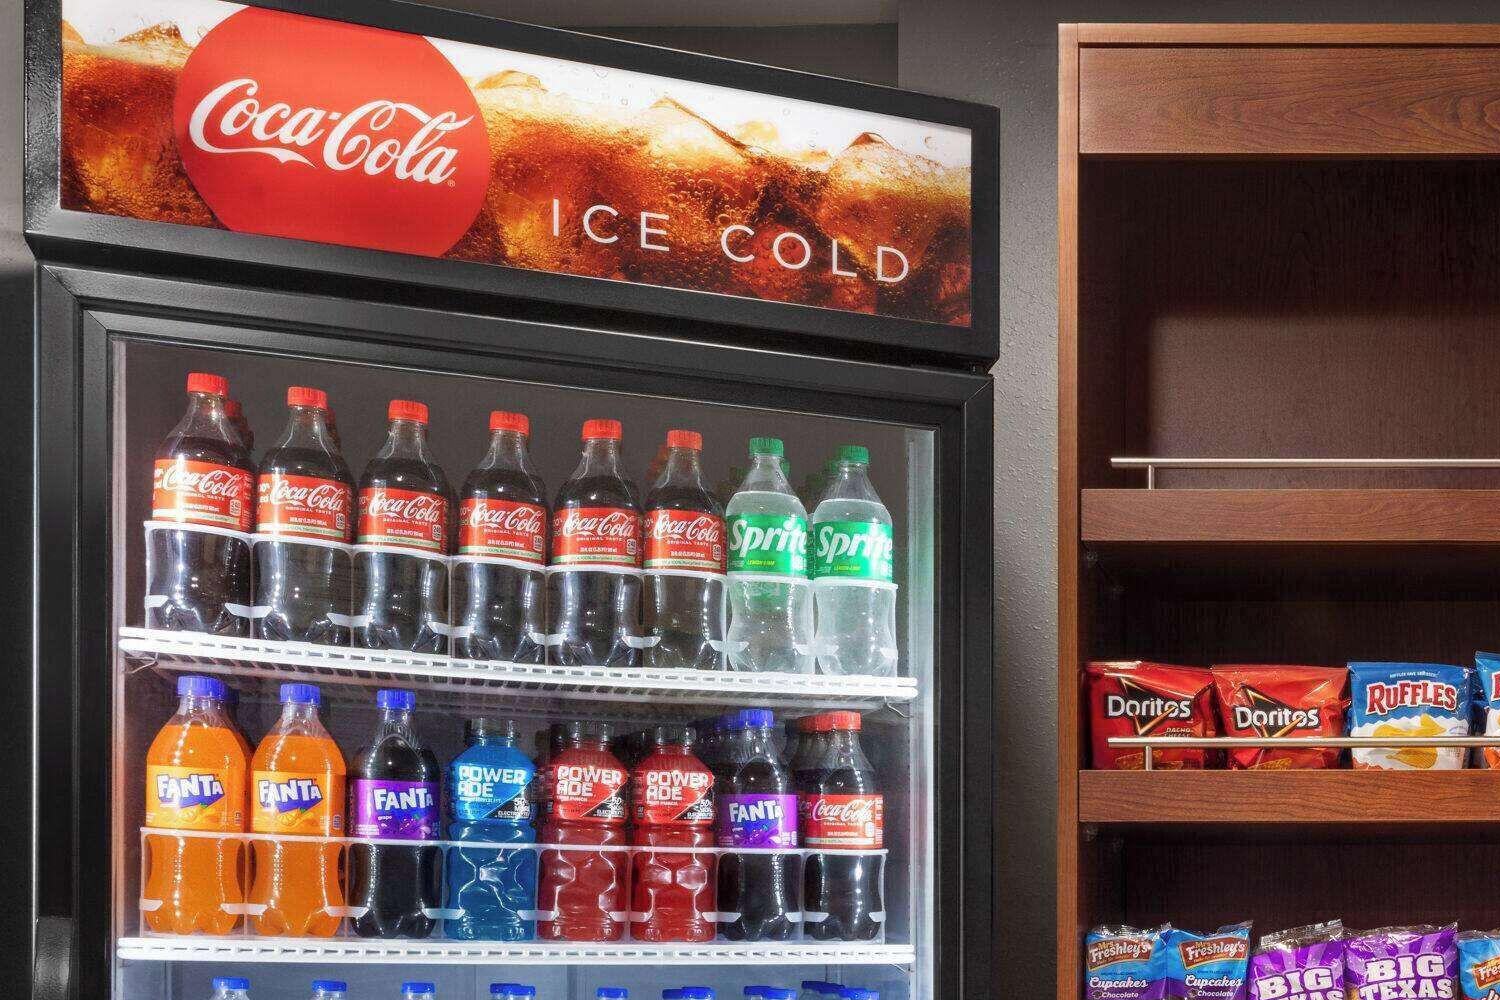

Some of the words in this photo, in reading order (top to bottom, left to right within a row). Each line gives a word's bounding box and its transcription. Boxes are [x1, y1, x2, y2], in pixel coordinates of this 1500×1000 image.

[189, 78, 475, 185] Coca-Cola
[552, 199, 670, 252] ICE
[721, 225, 911, 284] COLD
[162, 464, 242, 498] Coca-Cola
[271, 478, 345, 511] Coca-Cola
[368, 493, 441, 523] Coca-Cola
[470, 503, 543, 533] Coca-Cola
[563, 511, 635, 537] Coca-Cola
[653, 512, 719, 543] Coca-Cola
[1107, 695, 1191, 718] Doritos
[1367, 681, 1457, 714] RUFFLES
[1235, 706, 1320, 728] Doritos
[156, 774, 224, 799] FANTA
[458, 765, 527, 785] POWER
[557, 765, 622, 786] POWER
[646, 770, 709, 789] POWER
[258, 780, 322, 803] FANTA
[373, 788, 434, 811] FANTA
[729, 800, 784, 823] FANTA
[812, 799, 874, 822] Coca-Cola
[1091, 943, 1150, 962] Freshley's
[1186, 942, 1245, 960] Freshley's
[1367, 954, 1444, 983] BIG
[1090, 976, 1148, 989] Cupcakes
[1185, 974, 1243, 987] Cupcakes
[1257, 968, 1334, 1000] BIG
